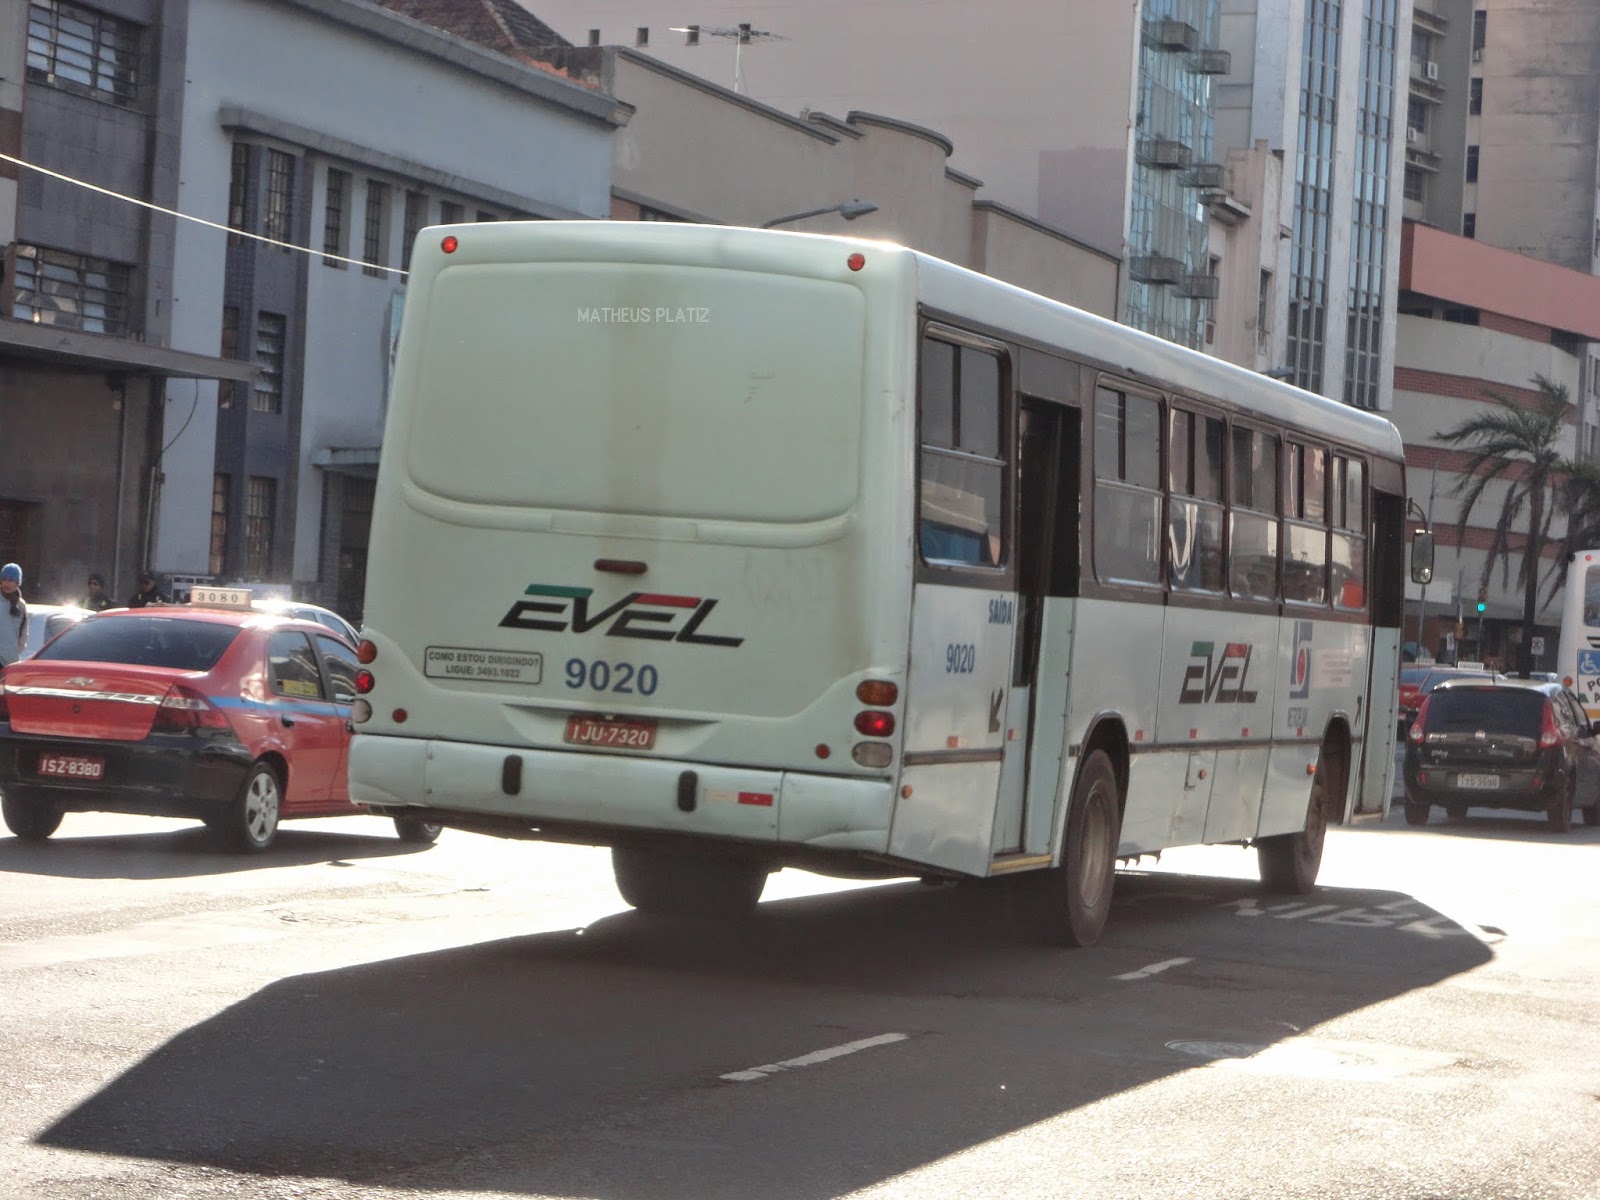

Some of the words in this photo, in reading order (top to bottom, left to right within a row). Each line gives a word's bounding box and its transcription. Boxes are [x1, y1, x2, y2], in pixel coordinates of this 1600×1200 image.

[198, 592, 239, 604] 3080
[988, 594, 1012, 625] SAÍDA
[498, 583, 745, 648] EVEL
[428, 651, 455, 662] COMO
[457, 653, 486, 664] ESTOU
[446, 664, 474, 676] LIGUE:
[946, 643, 975, 674] 9020
[1179, 641, 1258, 704] EVEL
[565, 658, 658, 696] 9020
